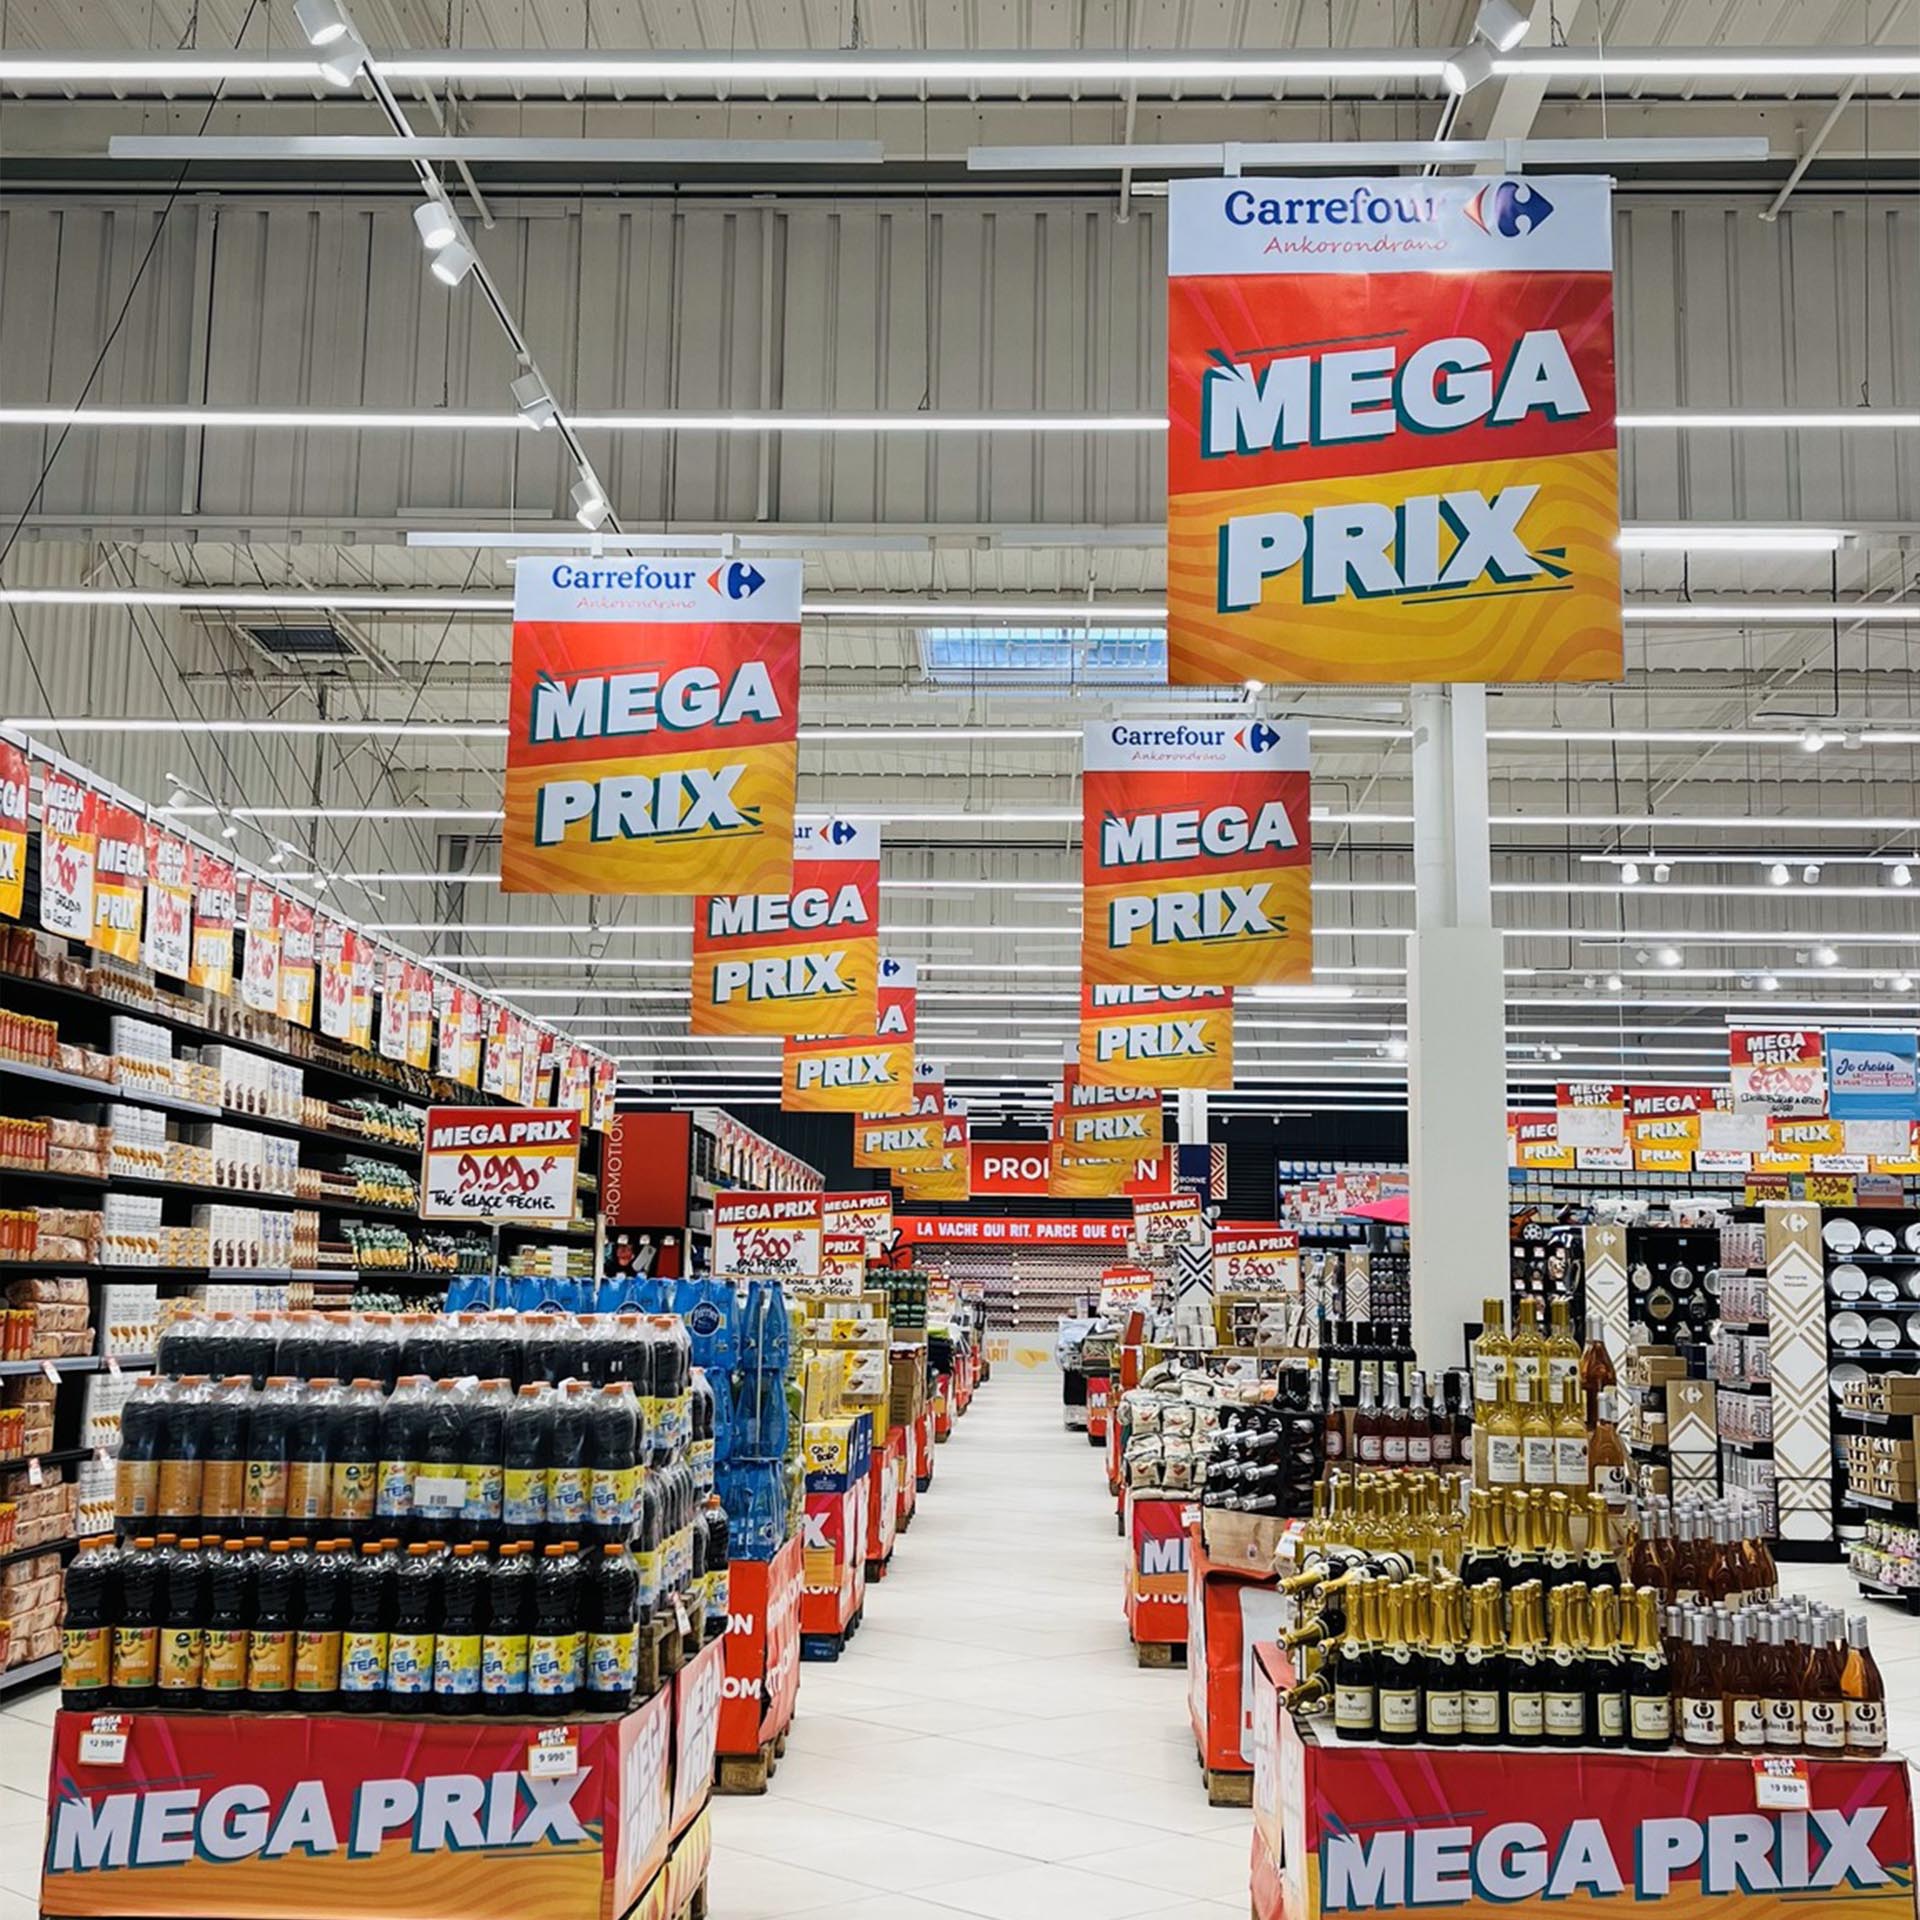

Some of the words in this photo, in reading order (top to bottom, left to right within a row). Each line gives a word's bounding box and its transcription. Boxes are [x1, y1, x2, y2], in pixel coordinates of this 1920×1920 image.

[1225, 187, 1447, 226] Carrefour
[1264, 234, 1448, 255] Ankorondrano
[1202, 329, 1591, 460] MEGA
[1218, 484, 1545, 613] PRIX
[552, 565, 695, 590] Carrefour
[530, 661, 782, 743] MEGA
[1111, 726, 1225, 746] Carrefour
[49, 777, 83, 811] MEGA
[535, 764, 750, 847] PRIX
[48, 808, 78, 836] PRIX
[1101, 801, 1298, 867] MEGA
[709, 884, 868, 938] MEGA
[1110, 882, 1273, 948] PRIX
[713, 951, 847, 1004] PRIX
[1098, 1018, 1207, 1061] PRIX
[1748, 1033, 1806, 1052] MEGA
[1753, 1048, 1801, 1065] PRIX
[798, 1052, 892, 1089] PRIX
[1072, 1085, 1156, 1106] MEGA
[1569, 1083, 1614, 1096] MEGA
[1573, 1093, 1611, 1107] PRIX
[1634, 1095, 1696, 1114] MEGA
[431, 1123, 506, 1148] MEGA
[509, 1119, 573, 1143] PRIX
[1075, 1113, 1146, 1142] PRIX
[1520, 1124, 1557, 1139] MEG
[1637, 1121, 1688, 1140] PRIX
[1780, 1124, 1833, 1143] PRIX
[864, 1127, 929, 1153] PRIX
[605, 1113, 624, 1226] PROMOTION
[718, 1202, 773, 1223] MEGA
[774, 1200, 818, 1219] PRIX
[824, 1200, 858, 1212] MEGA
[860, 1196, 888, 1208] PRIX
[1136, 1201, 1168, 1214] MEGA
[1169, 1198, 1196, 1210] PRIX
[917, 1222, 934, 1237] LA
[938, 1223, 978, 1237] VACHE
[983, 1223, 1005, 1238] QUI
[1037, 1224, 1078, 1238] PARCE
[1082, 1224, 1107, 1238] QUE
[824, 1240, 860, 1254] PRIX
[1215, 1240, 1258, 1255] MEGA
[1259, 1236, 1294, 1250] PRIX
[555, 1491, 583, 1505] TEA
[350, 1657, 378, 1672] TEA
[391, 1659, 417, 1673] TEA
[532, 1660, 559, 1674] TEA
[591, 1658, 619, 1673] TEA
[46, 1780, 337, 1874] MEGA
[350, 1766, 592, 1855] PRIX
[1322, 1818, 1624, 1914] MEGA
[1635, 1805, 1891, 1903] PRIX
